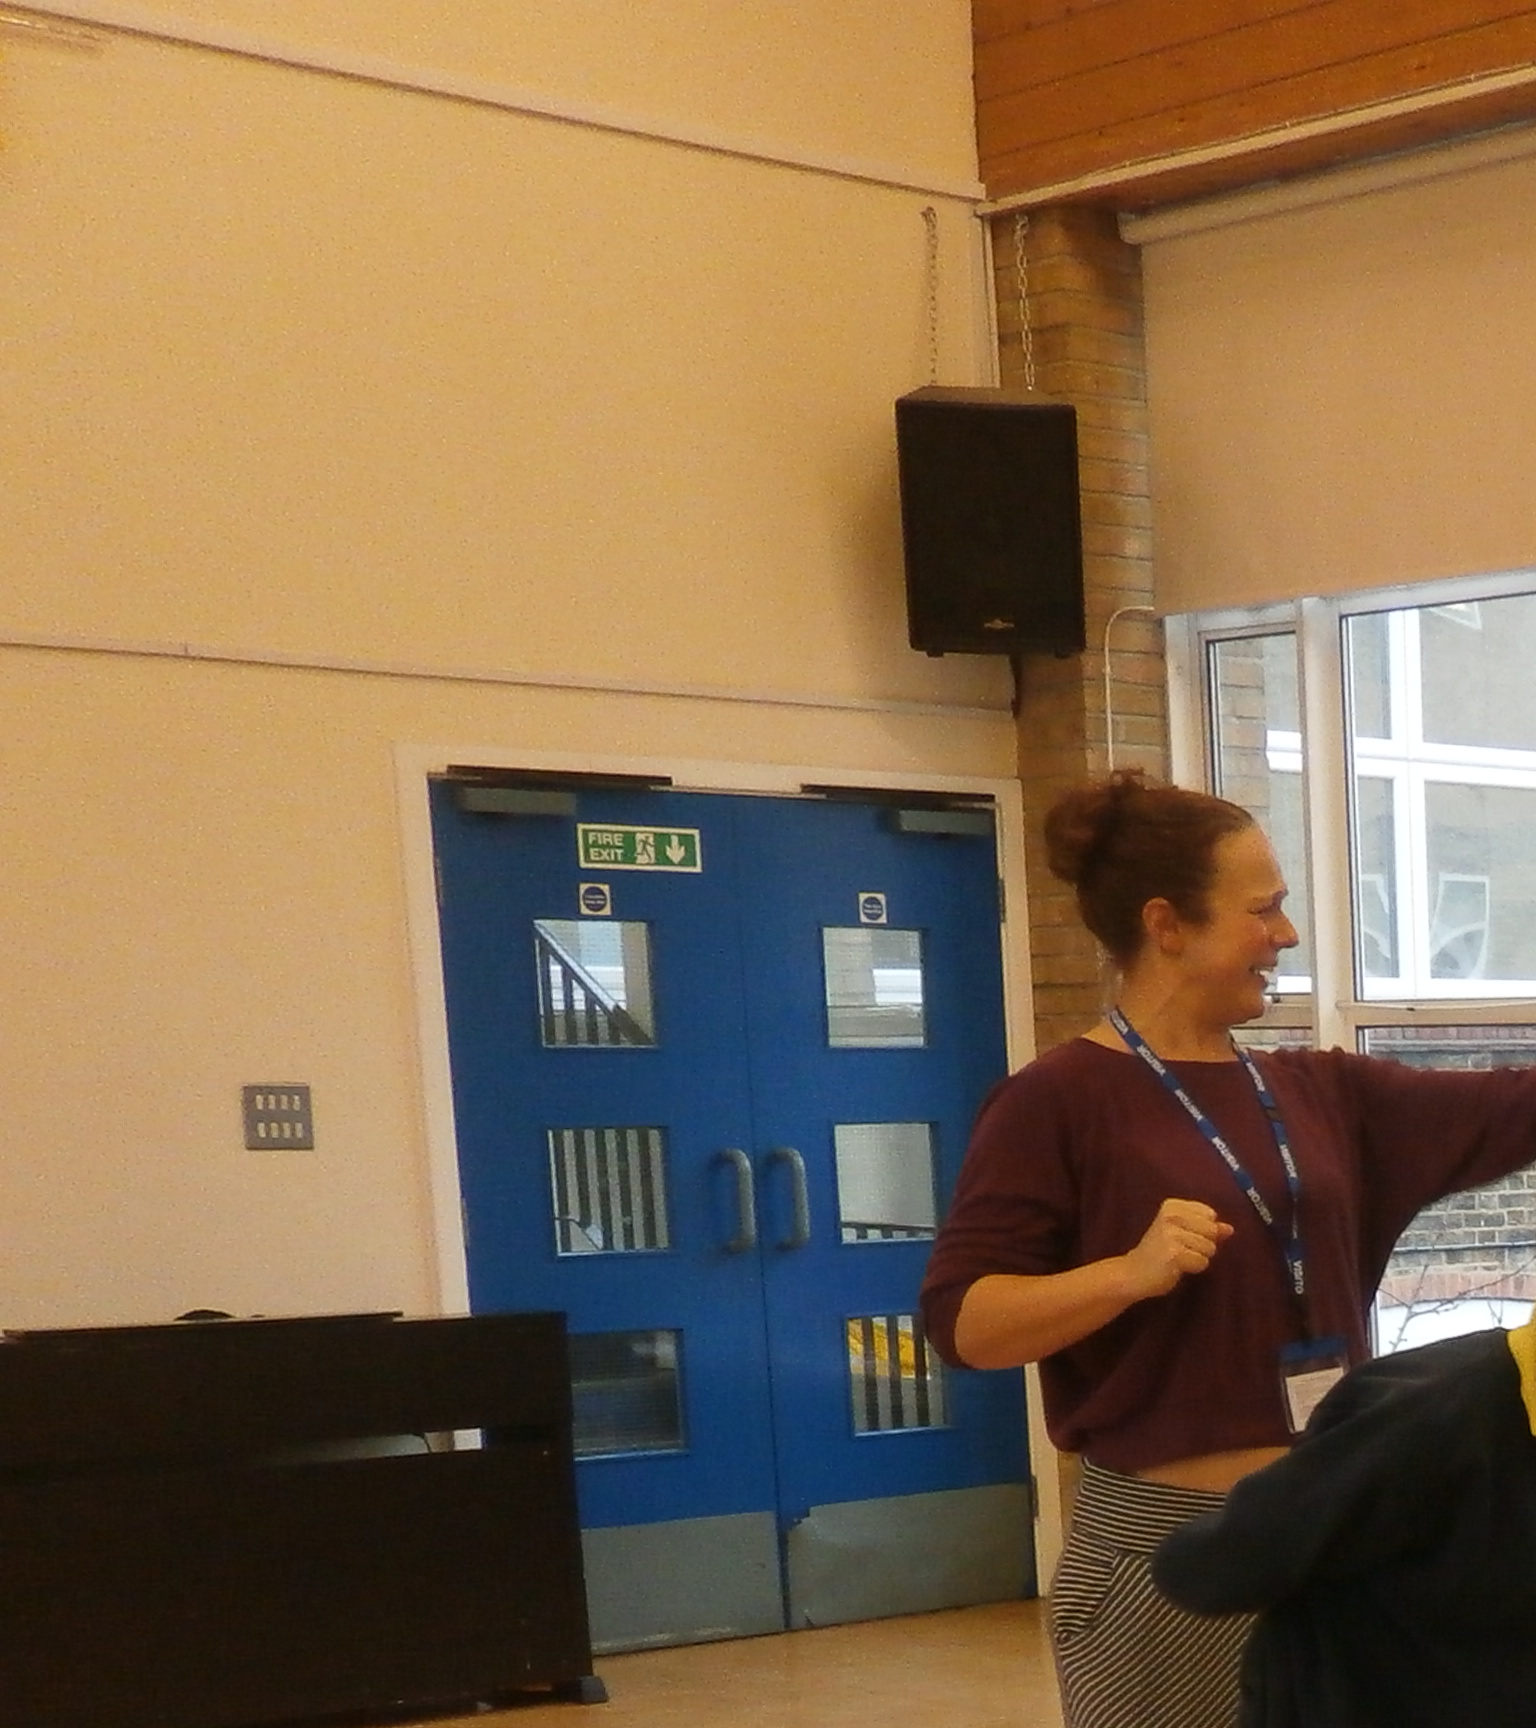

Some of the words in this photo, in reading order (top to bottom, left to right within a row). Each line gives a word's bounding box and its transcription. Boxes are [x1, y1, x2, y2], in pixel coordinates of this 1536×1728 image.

[588, 832, 624, 846] FIRE
[589, 848, 624, 861] EXIT
[1137, 1045, 1166, 1076] VISITOR
[1175, 1089, 1204, 1120] VISITOR
[1212, 1136, 1240, 1171] VISITOR
[1246, 1186, 1272, 1225] VISITOR
[1293, 1260, 1304, 1295] VISITO
